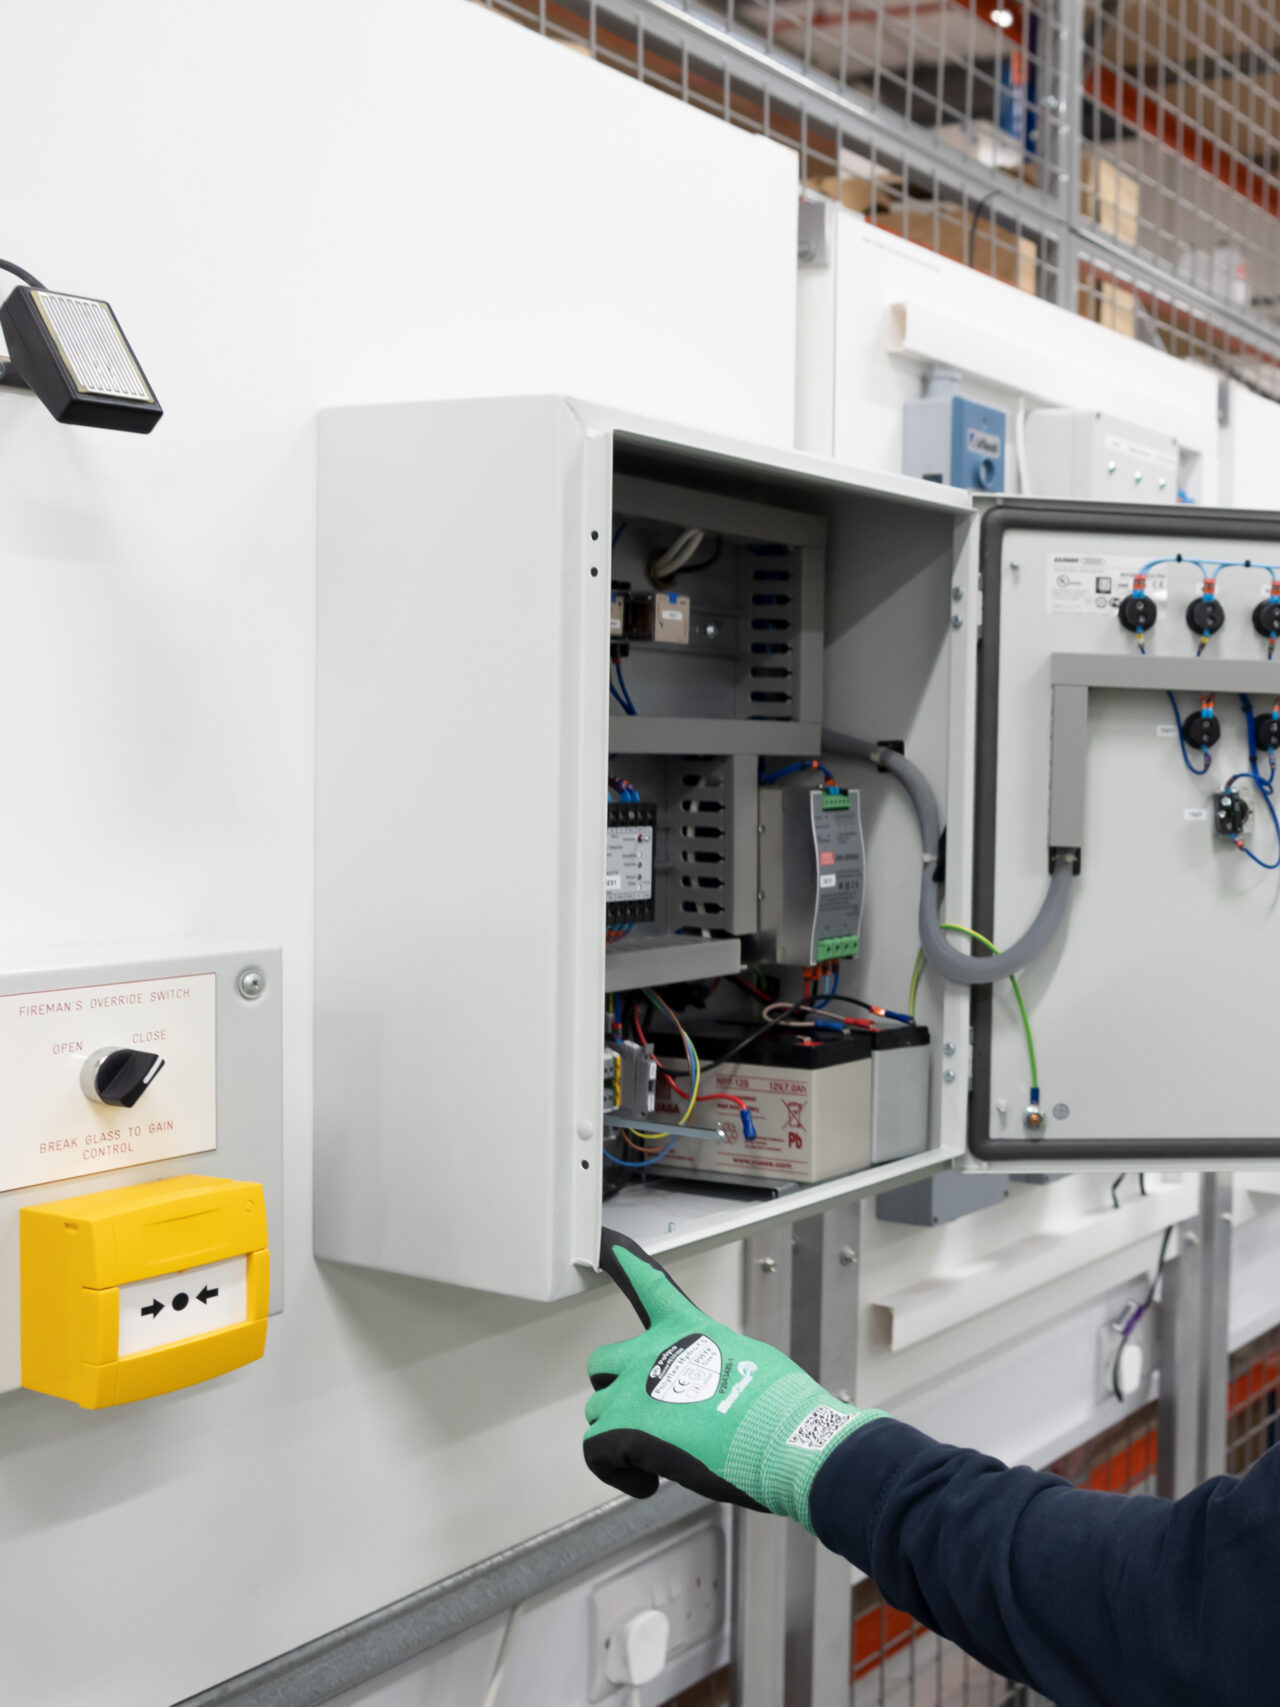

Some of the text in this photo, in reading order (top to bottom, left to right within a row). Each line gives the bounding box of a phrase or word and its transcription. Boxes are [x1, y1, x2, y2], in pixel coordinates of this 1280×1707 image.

[19, 988, 190, 1017] FIREMAN'S OVERRIDE SWITCH
[132, 1029, 167, 1044] CLOSE
[52, 1041, 83, 1055] OPEN
[40, 1120, 174, 1154] BREAK GLASS TO GAIN
[788, 1131, 803, 1150] Pb
[82, 1142, 134, 1160] CONTROL
